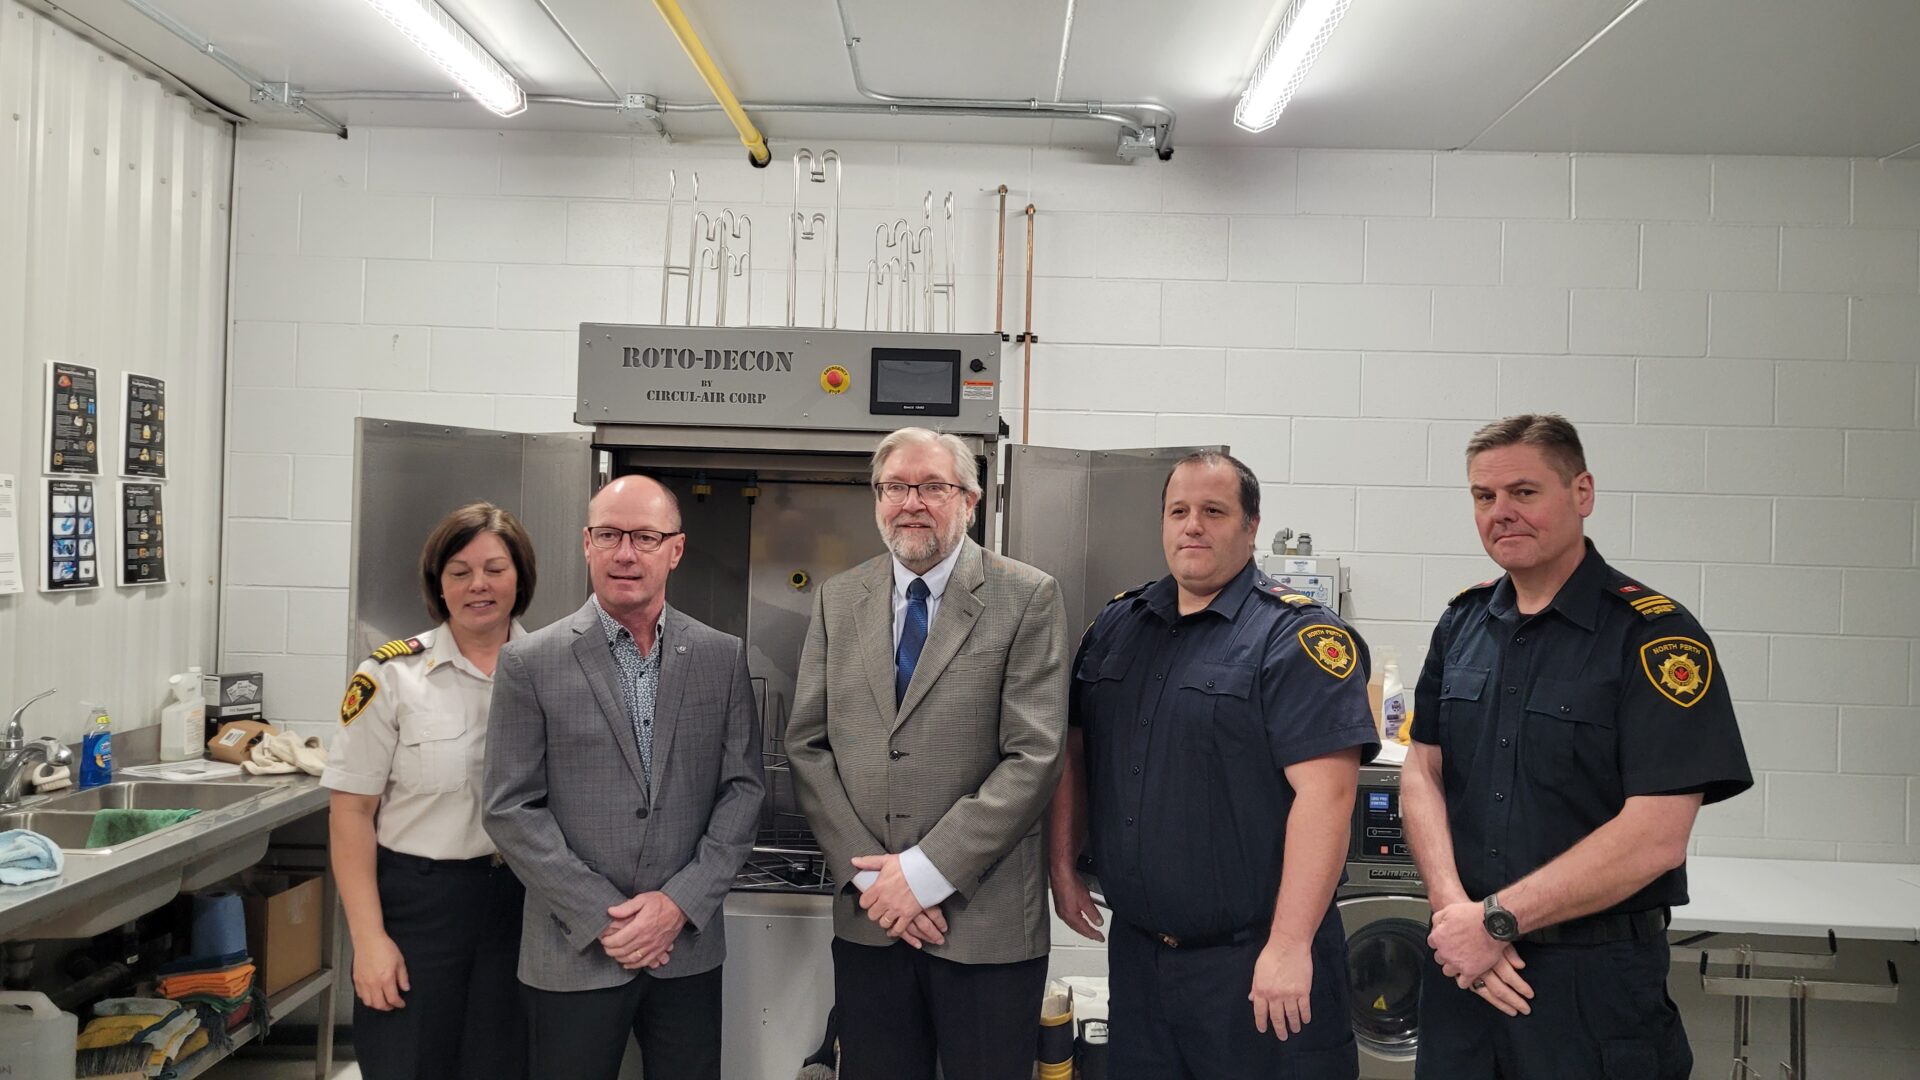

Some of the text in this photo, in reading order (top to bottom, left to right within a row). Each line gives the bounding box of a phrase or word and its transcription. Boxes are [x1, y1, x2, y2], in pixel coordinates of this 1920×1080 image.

[622, 346, 794, 372] ROTO-DECON
[823, 365, 848, 376] EMERGENCY
[701, 380, 713, 388] BY
[646, 390, 767, 404] CIRCUL-AIR CORP
[1652, 643, 1701, 655] NORTH PERTH
